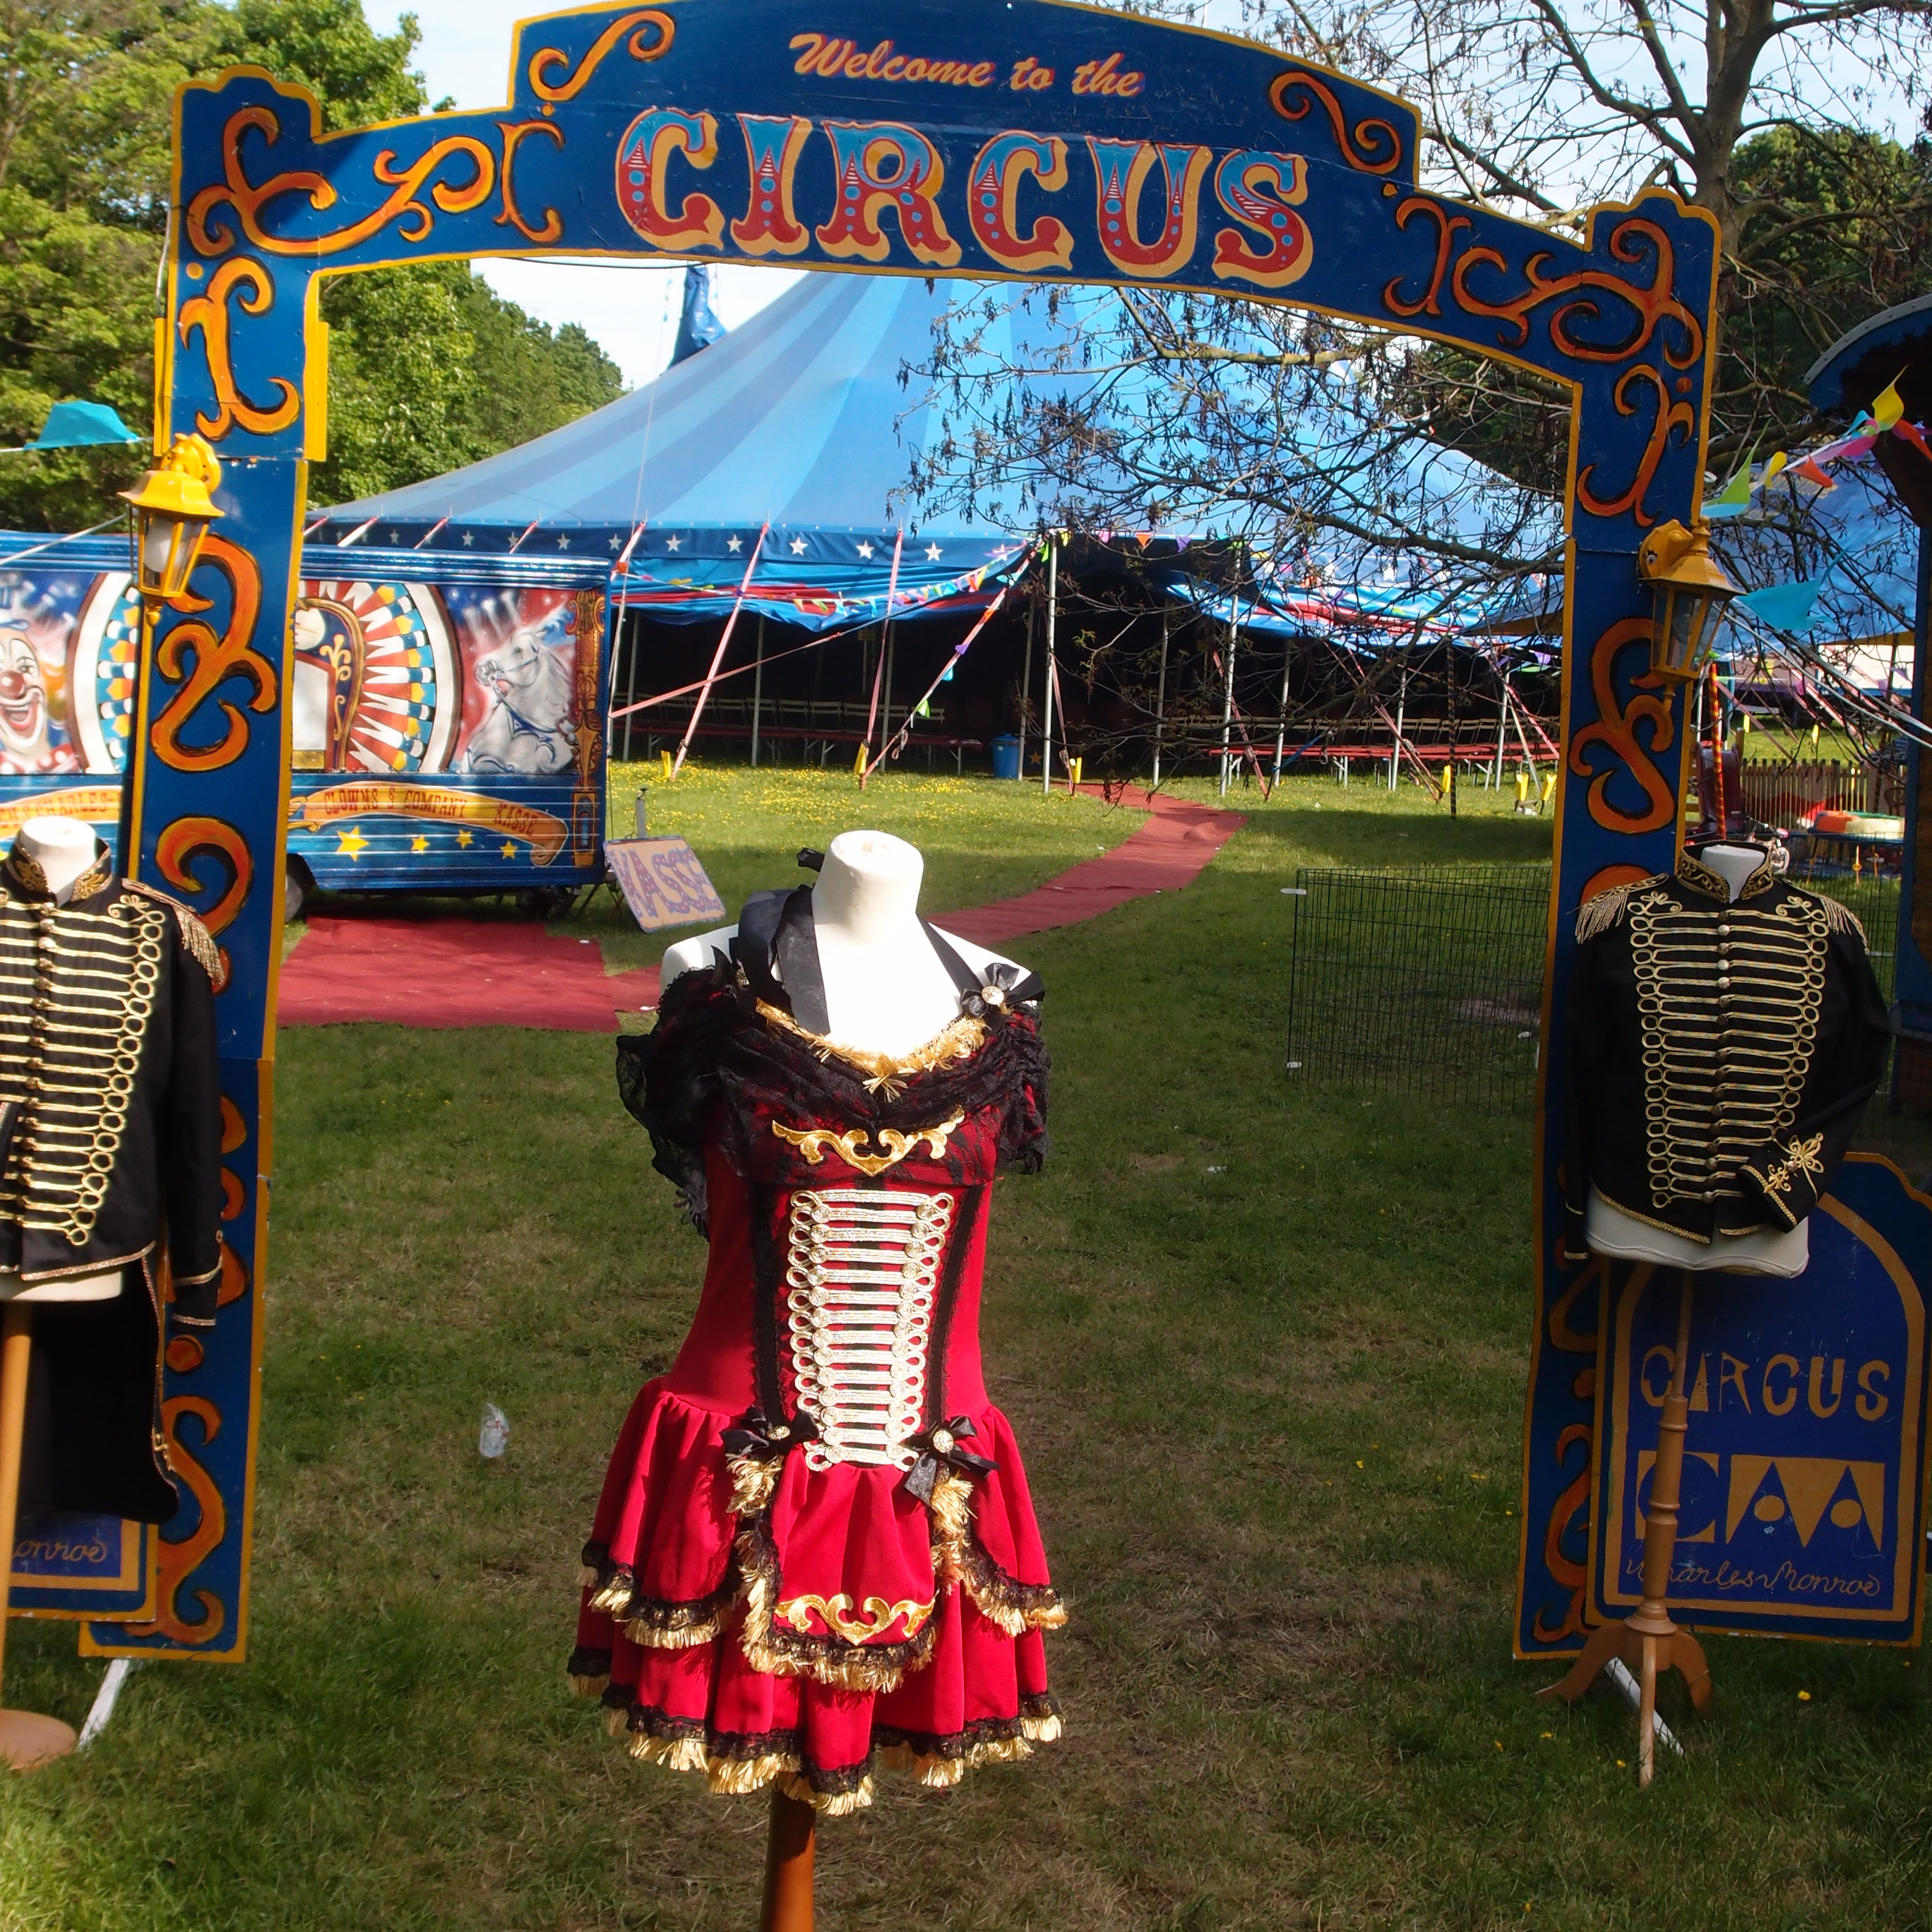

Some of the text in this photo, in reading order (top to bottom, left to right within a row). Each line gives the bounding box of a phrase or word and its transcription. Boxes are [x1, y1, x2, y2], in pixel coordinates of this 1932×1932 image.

[789, 33, 1144, 97] Welcome to the
[615, 106, 1313, 287] CIRCUS
[324, 787, 379, 815] CLOWNS
[404, 789, 468, 818] COMPANY
[494, 802, 538, 836] KASSE
[608, 847, 724, 918] KASSE
[1640, 1345, 1890, 1421] CIRCUS
[11, 1536, 107, 1563] onroe
